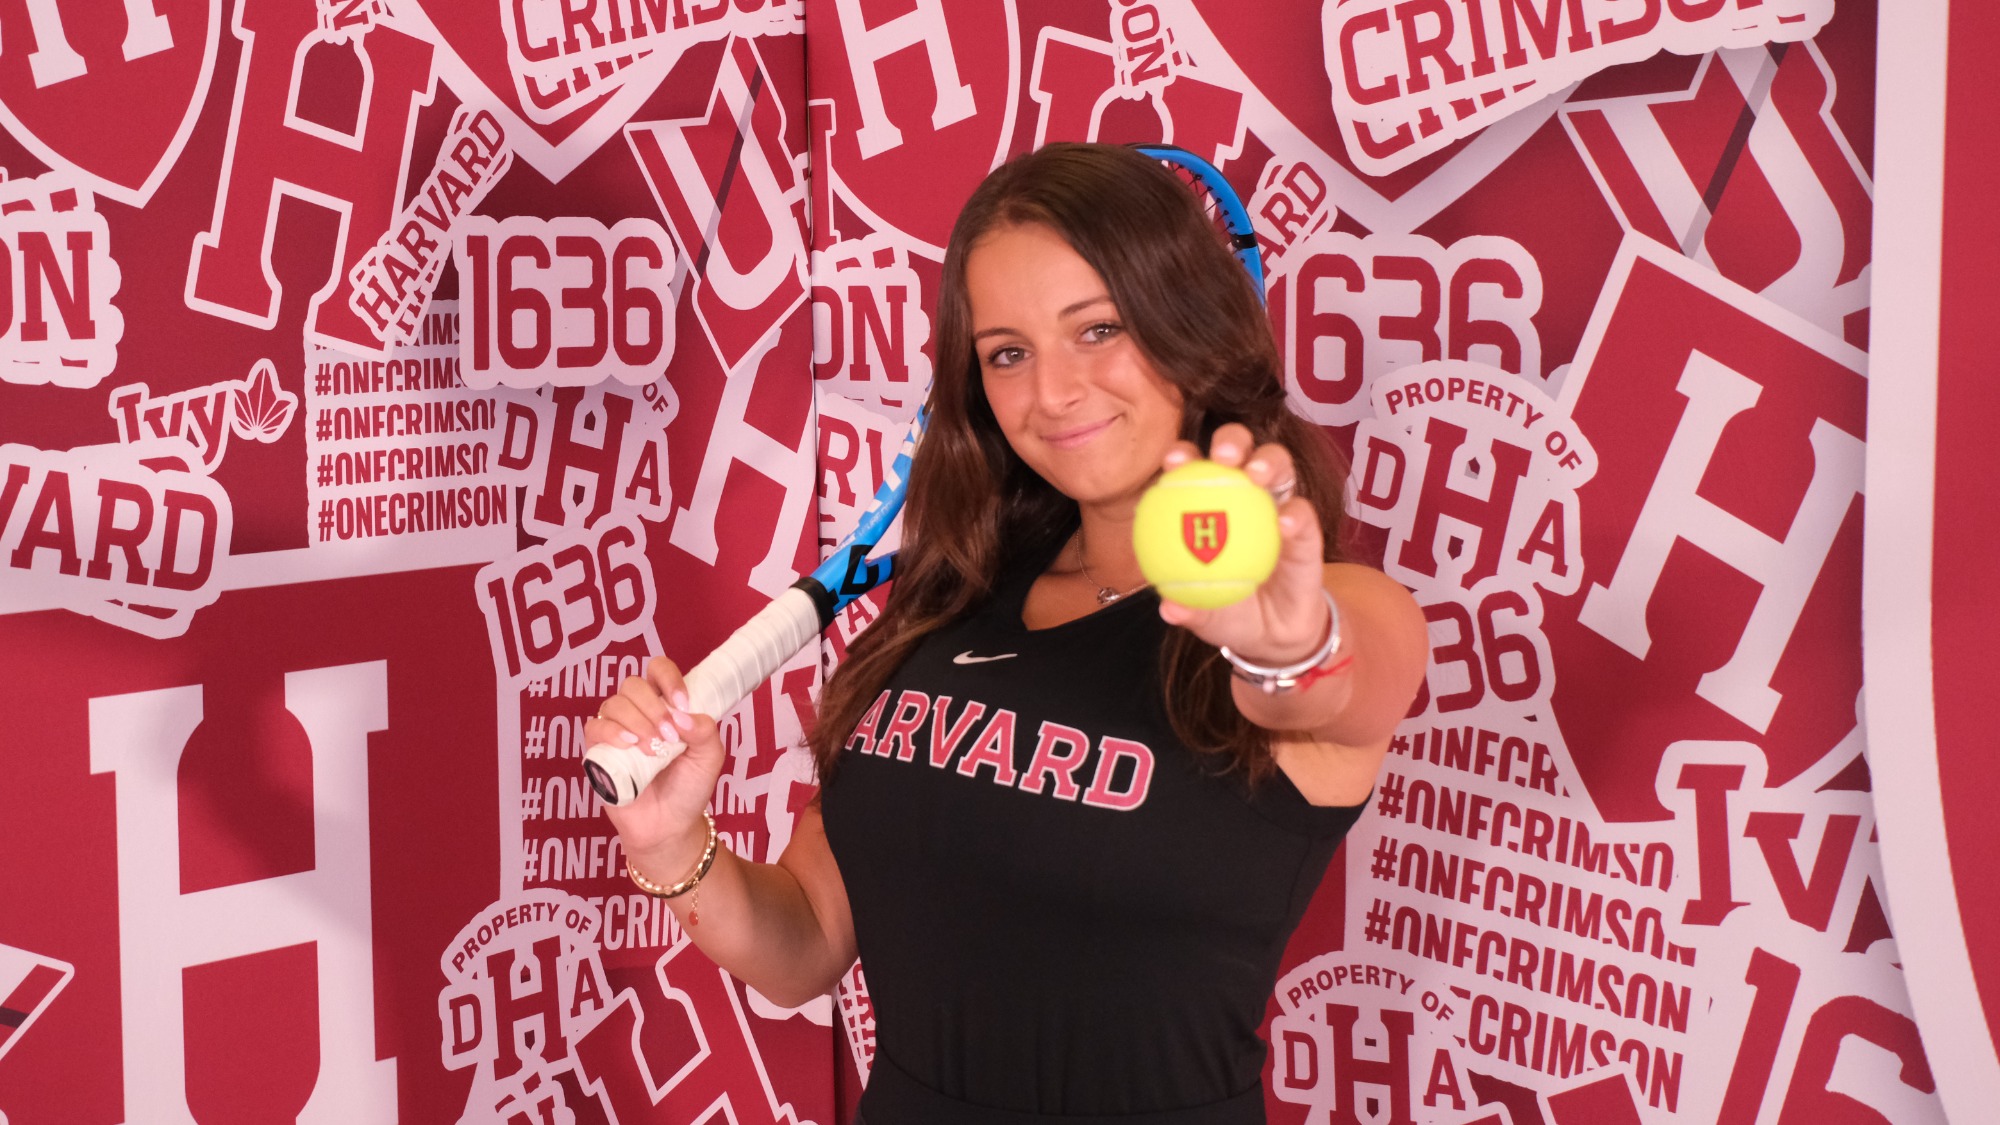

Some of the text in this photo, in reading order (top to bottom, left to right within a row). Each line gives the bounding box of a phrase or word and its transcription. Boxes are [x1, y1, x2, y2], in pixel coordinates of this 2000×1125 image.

[1119, 0, 1168, 87] ON
[356, 109, 505, 332] HARVARD
[467, 235, 664, 371] 1636
[117, 391, 227, 465] Ivy
[642, 383, 668, 413] OF
[1385, 377, 1582, 471] PROPERTY OF
[318, 442, 487, 487] #ONECRIMSO
[318, 485, 508, 542] #ONECRIMSON
[1193, 517, 1217, 549] H
[1577, 348, 1867, 736] H
[488, 525, 646, 678] 1636
[845, 689, 1155, 811] ARVARD
[89, 659, 399, 1125] H
[1677, 763, 1879, 932] Iv
[452, 903, 592, 973] PROPERTY OF
[1364, 899, 1692, 1034] #ONECRIMSON
[1286, 965, 1454, 1022] PROPERTY OF
